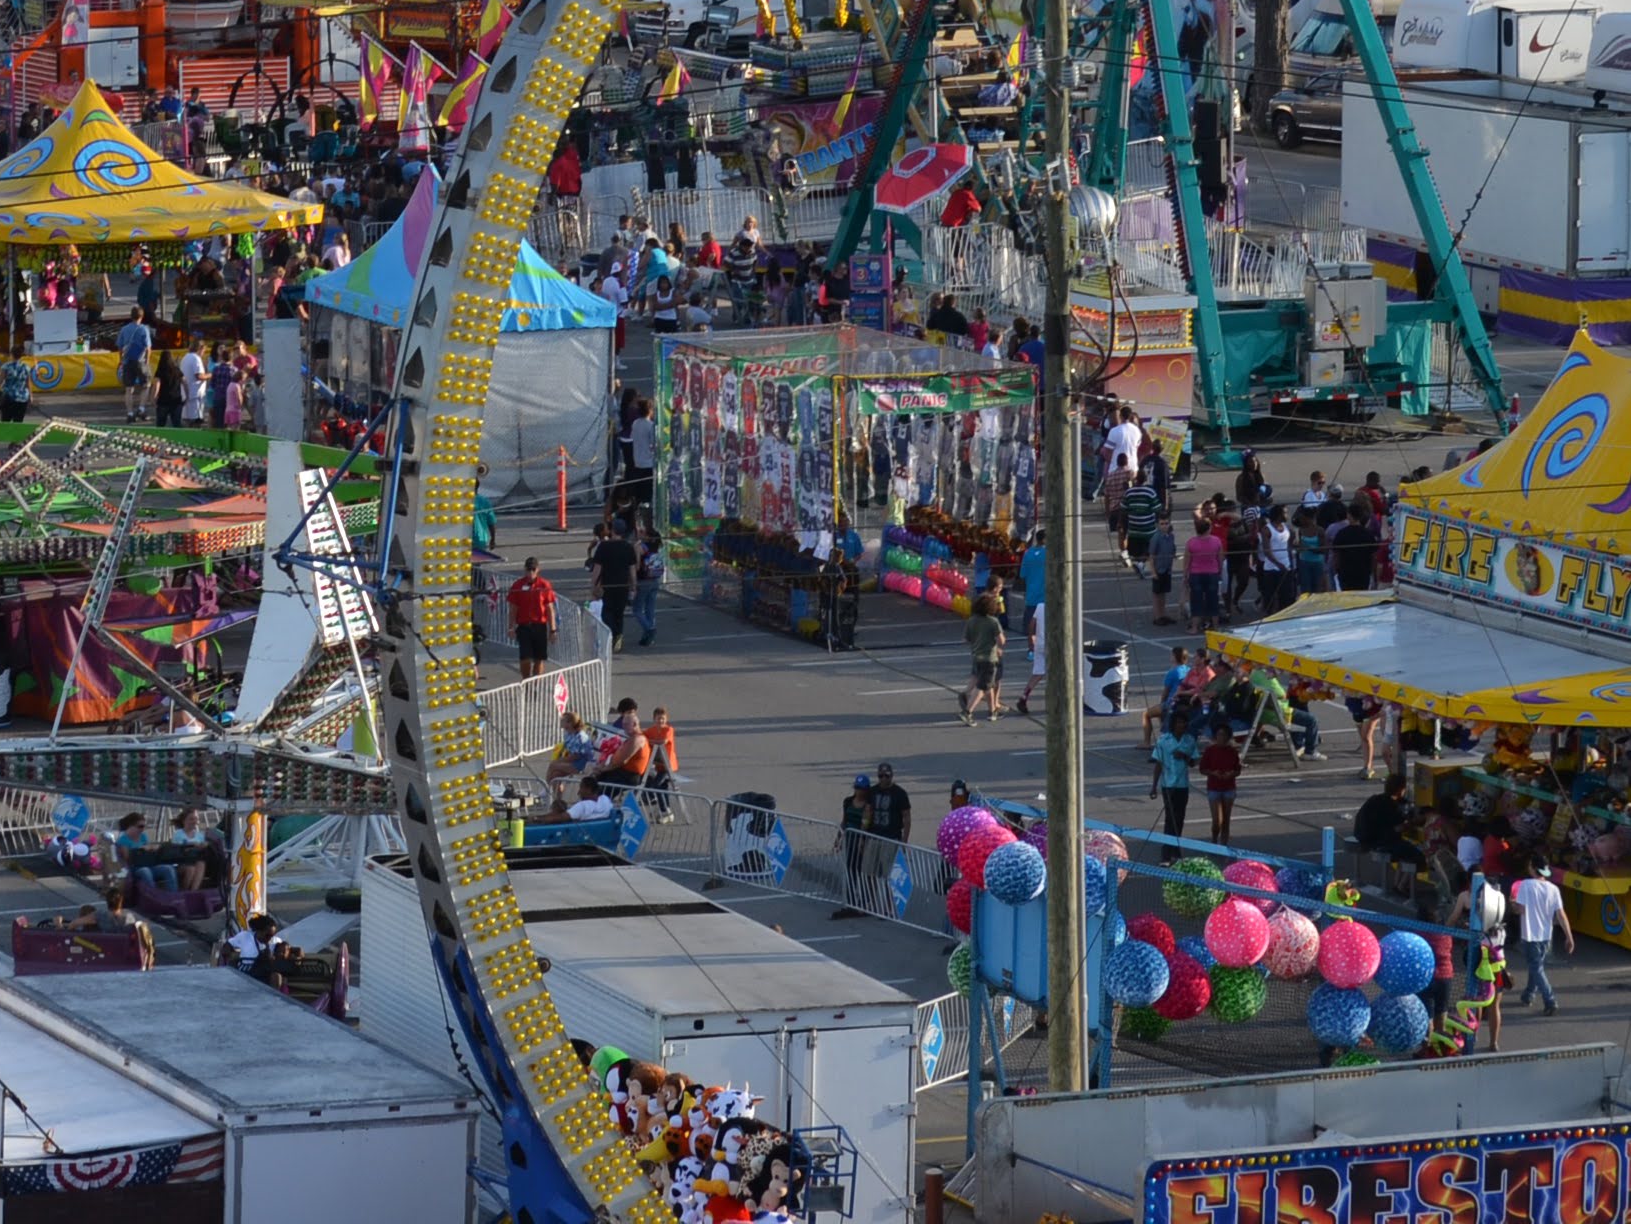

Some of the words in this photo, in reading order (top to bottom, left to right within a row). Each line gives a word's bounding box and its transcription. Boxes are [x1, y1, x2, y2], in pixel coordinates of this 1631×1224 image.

[742, 354, 829, 378] PANIC
[900, 392, 948, 409] PANIC
[1398, 514, 1498, 586] FIRE
[1555, 553, 1631, 619] FLY
[1167, 1138, 1631, 1224] FIRESTO
